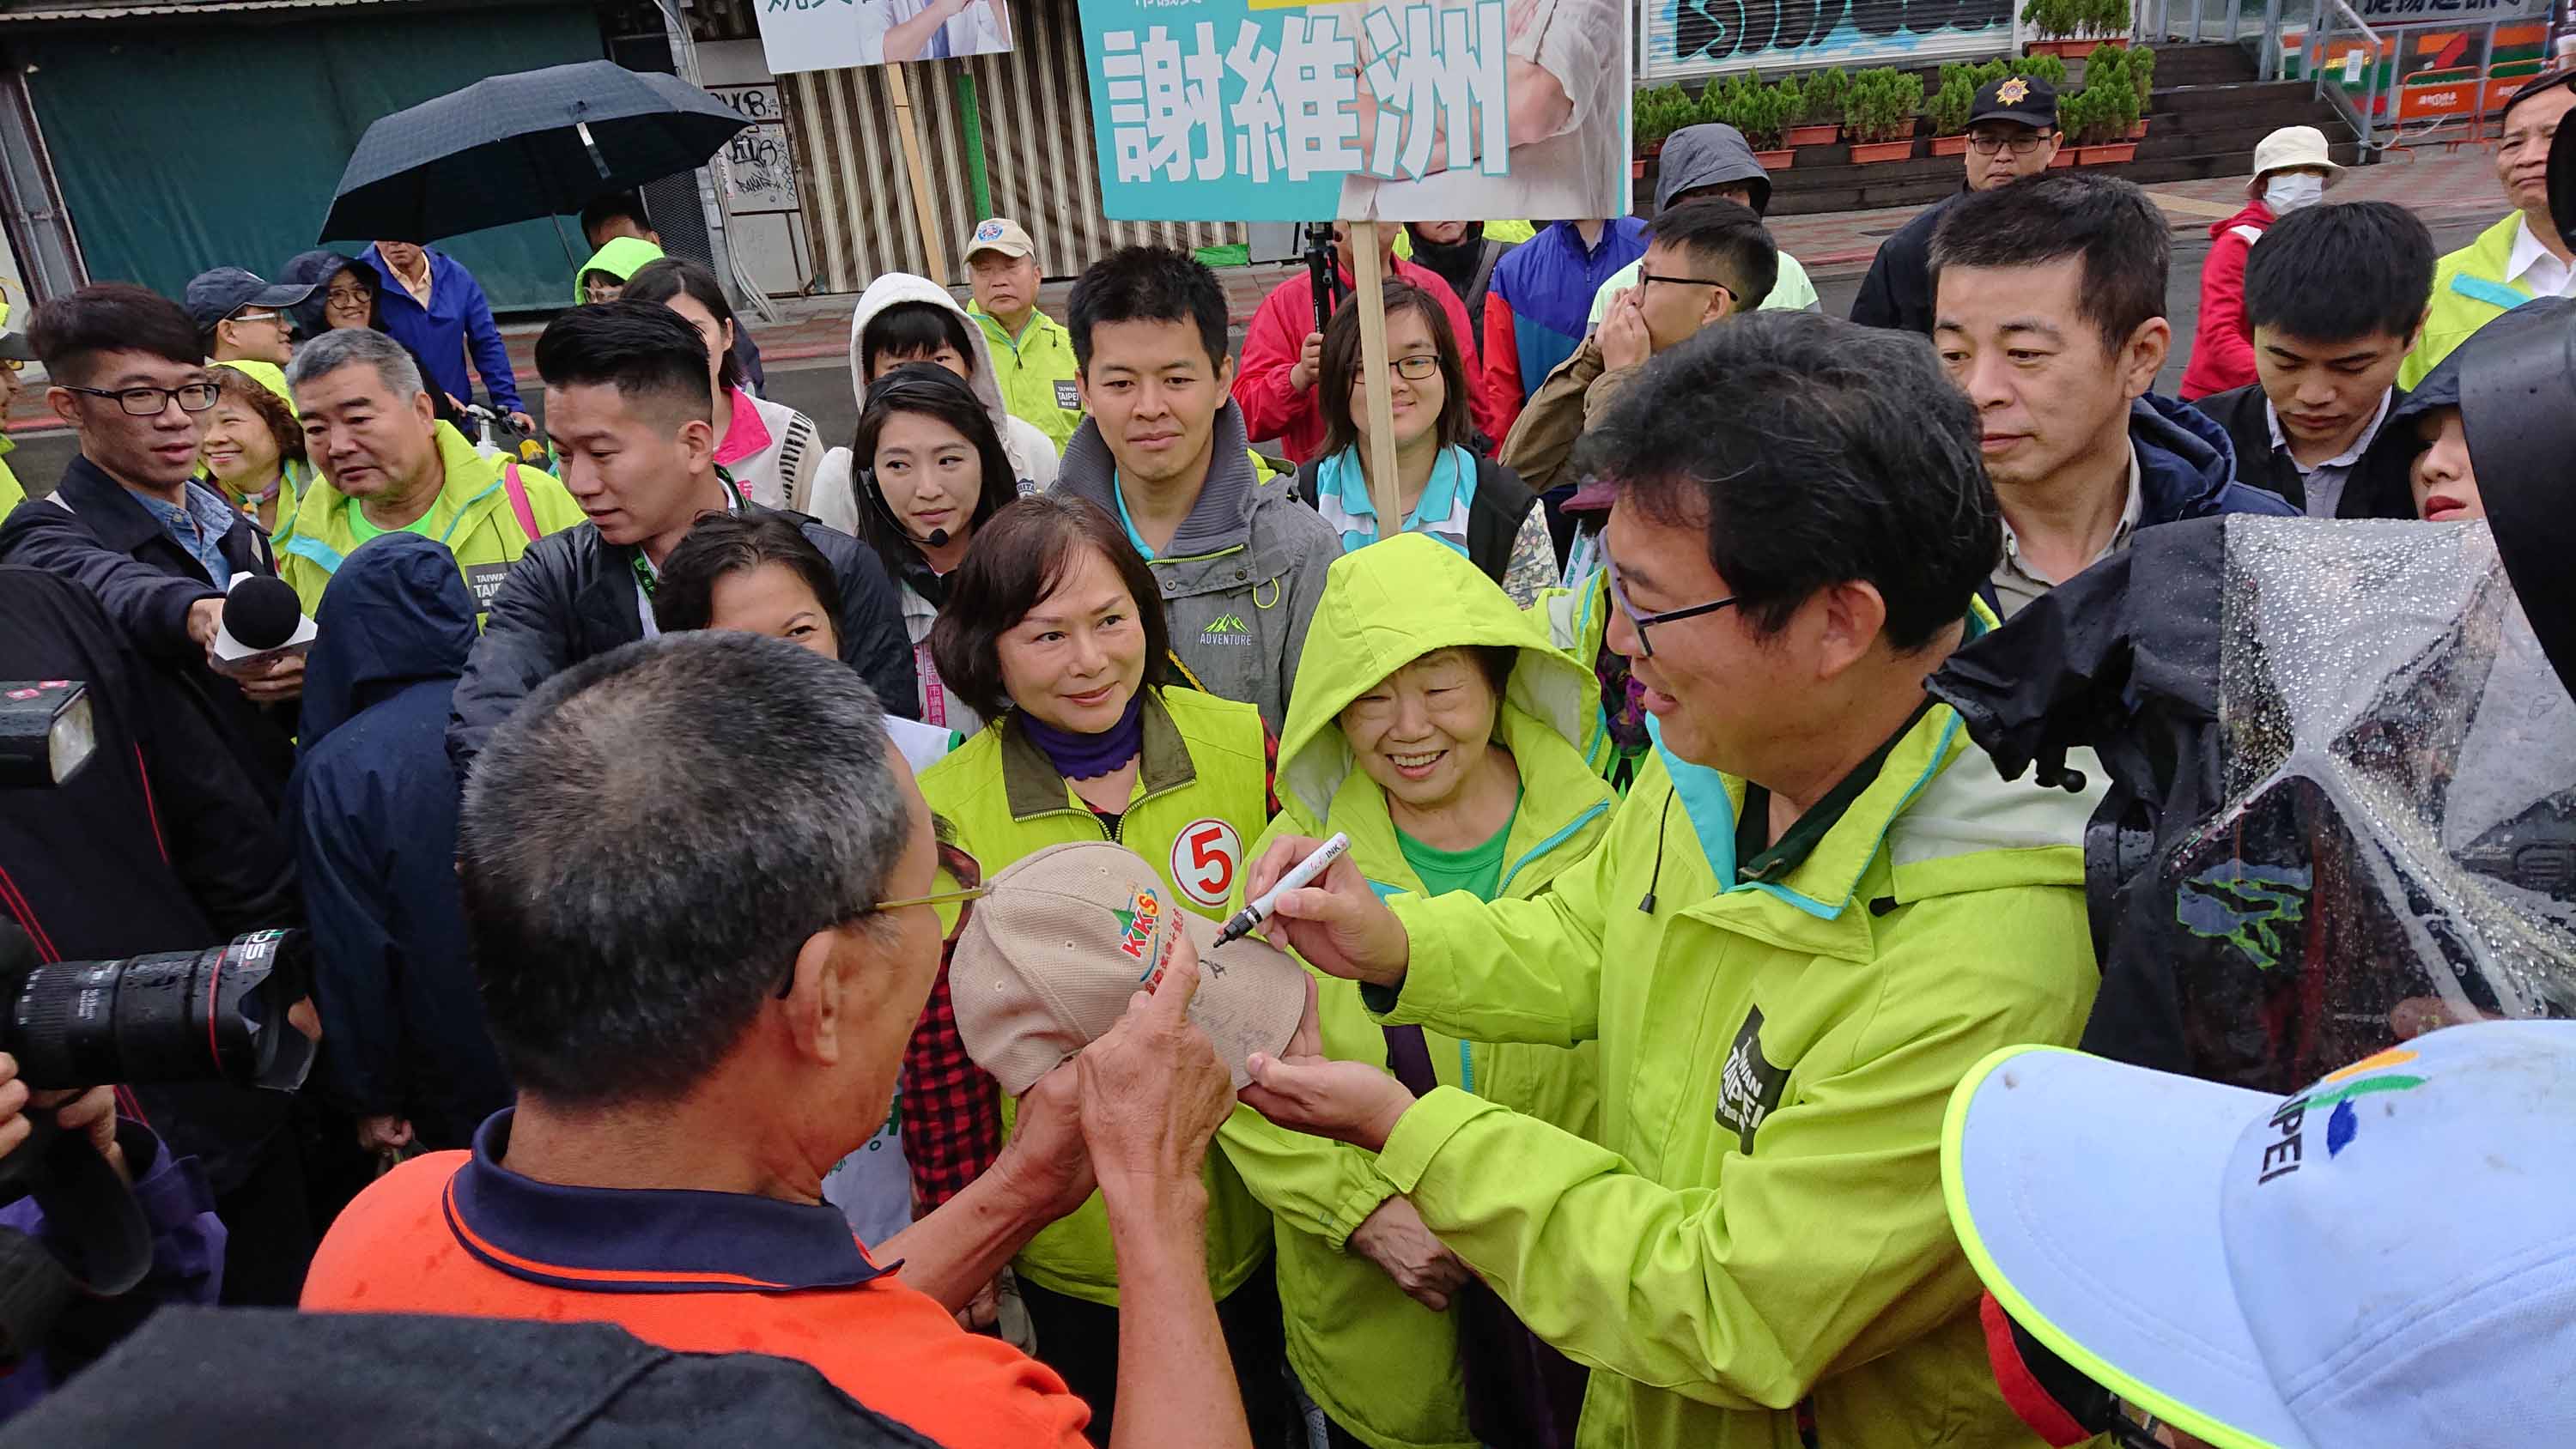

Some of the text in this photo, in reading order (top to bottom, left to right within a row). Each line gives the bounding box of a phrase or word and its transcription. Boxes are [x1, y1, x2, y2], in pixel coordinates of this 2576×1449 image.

[1103, 2, 1510, 183] 謝維洲
[1057, 391, 1079, 401] TAIPEI
[1200, 633, 1253, 646] ADVENTURE
[1190, 827, 1233, 894] 5
[1325, 843, 1341, 859] INK
[1120, 893, 1159, 959] KKS
